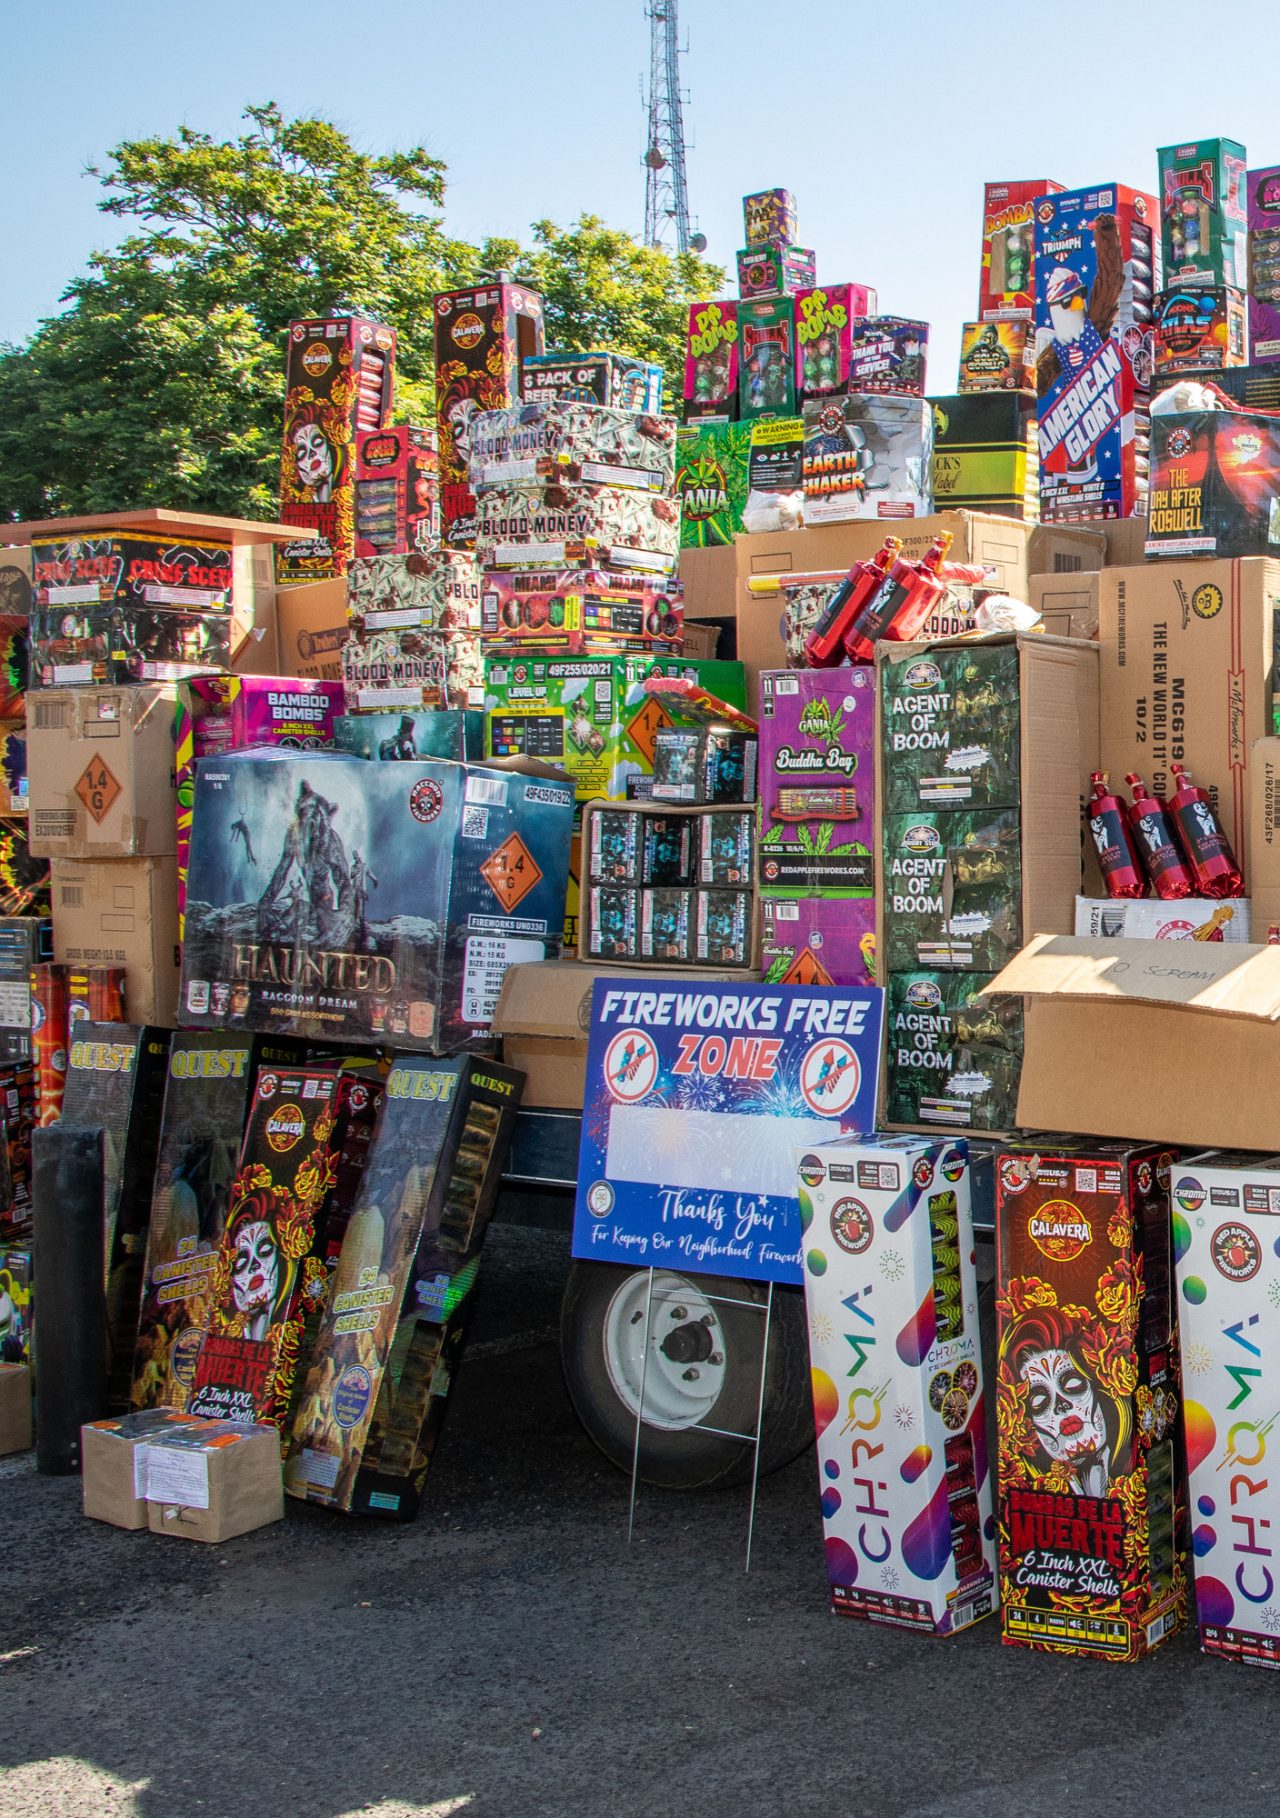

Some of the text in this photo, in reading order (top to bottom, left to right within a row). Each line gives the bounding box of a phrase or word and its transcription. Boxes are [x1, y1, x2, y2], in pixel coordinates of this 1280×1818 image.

[1042, 235, 1082, 255] TRIUMPH
[796, 304, 848, 345] BOMB
[690, 319, 739, 358] BOMB
[523, 388, 558, 405] BEER
[1038, 346, 1122, 459] AMERICAN
[1064, 388, 1122, 463] GLORY
[803, 451, 858, 474] EARTH
[1169, 468, 1188, 488] THE
[1150, 486, 1201, 510] DAY AFTER
[481, 515, 589, 537] BLOOD MONEY
[1149, 510, 1204, 534] ROSWELL
[346, 661, 441, 681] BLOOD MONEY
[548, 662, 613, 678] 49F255/020/21
[267, 692, 330, 709] BAMBOO
[892, 693, 951, 715] AGENT
[272, 706, 325, 722] BOMBS
[911, 714, 936, 732] OF
[1136, 697, 1147, 744] 10/2
[1172, 678, 1186, 761] MC619
[893, 733, 951, 752] BOOM
[777, 748, 856, 776] Buddha Bag
[85, 770, 108, 791] 1.4
[92, 792, 104, 809] G
[1265, 763, 1275, 845] 43F268/026/17
[499, 853, 525, 874] 1.4
[891, 858, 947, 877] AGENT
[506, 876, 515, 889] G
[908, 877, 931, 896] OF
[893, 895, 944, 914] BOOM
[472, 917, 544, 932] FIREWORKS UN0336
[230, 944, 396, 995] HAUNTED
[261, 990, 359, 1009] RACCOON DREAM
[600, 991, 872, 1036] FIREWORKS FREE
[895, 1012, 952, 1033] AGENT
[914, 1032, 939, 1050] OF
[69, 1041, 136, 1072] QUEST
[171, 1047, 249, 1078] QUEST
[671, 1034, 785, 1081] ZONE
[897, 1050, 952, 1071] BOOM
[386, 1069, 458, 1101] QUEST
[470, 1071, 516, 1096] QUEST
[267, 1118, 304, 1138] CALAVERA
[1174, 1188, 1208, 1201] CHROMA
[658, 1190, 728, 1231] Thanks
[735, 1195, 775, 1241] You
[834, 1229, 871, 1251] FIREWORKS
[1030, 1219, 1090, 1241] CALAVERA
[176, 1236, 198, 1257] 24
[152, 1250, 220, 1284] CANISTER
[359, 1267, 380, 1286] 24
[1215, 1258, 1257, 1280] FIREWORKS
[157, 1277, 210, 1305] SHELLS
[332, 1284, 395, 1316] CANISTER
[333, 1313, 379, 1336] SHELLS
[190, 1401, 256, 1423] Canister Shells
[1078, 1500, 1099, 1519] DE
[1101, 1501, 1122, 1521] LA
[1010, 1513, 1125, 1568] MUERTE
[1023, 1550, 1109, 1577] 6 Inch XXL
[1016, 1568, 1120, 1597] Canister Shells
